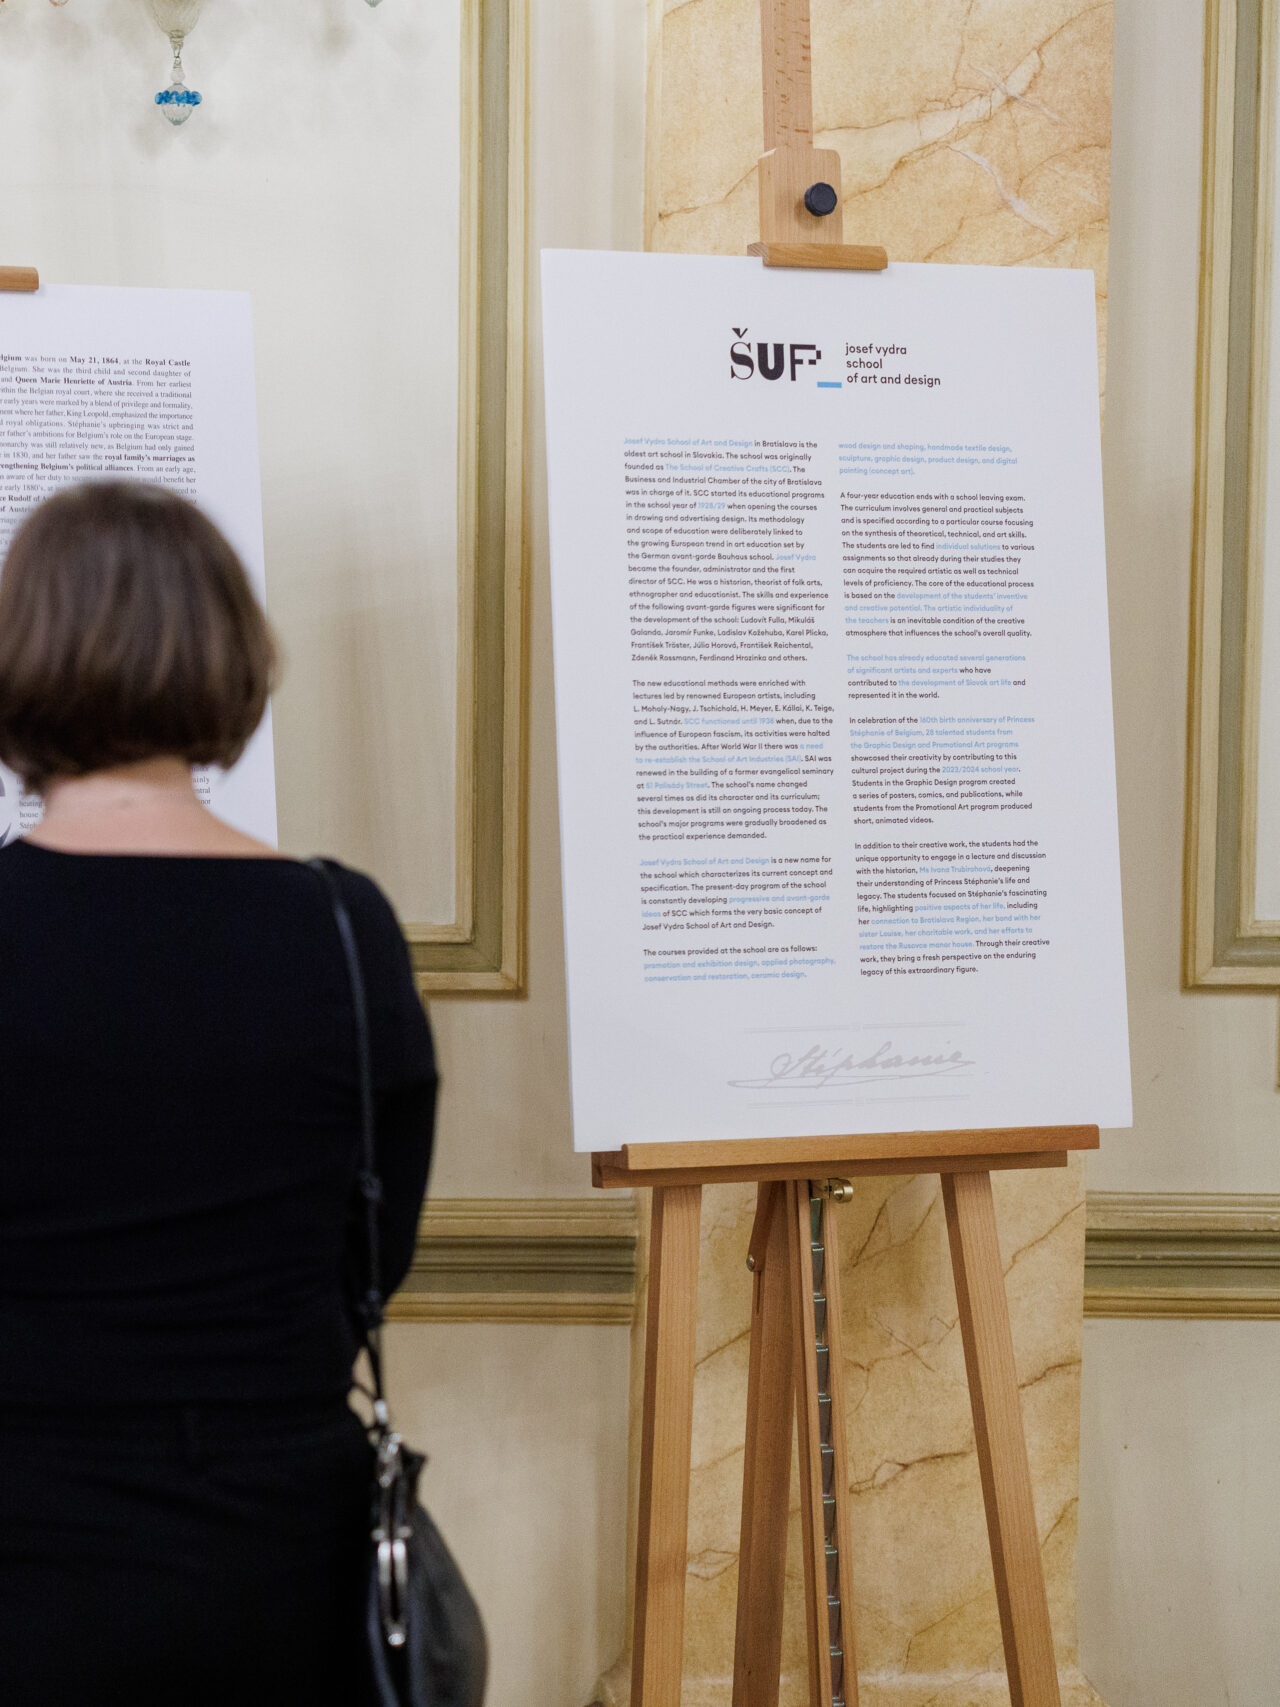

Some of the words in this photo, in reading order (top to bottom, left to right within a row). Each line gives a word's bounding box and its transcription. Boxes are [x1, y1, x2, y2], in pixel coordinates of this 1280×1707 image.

[845, 342, 873, 356] josef
[875, 344, 907, 357] vydra
[69, 355, 85, 364] May
[88, 356, 99, 364] 21,
[144, 358, 166, 366] Royal
[167, 359, 190, 367] Castle
[846, 357, 883, 369] school
[14, 376, 37, 384] Queen
[39, 376, 60, 384] Marie
[63, 377, 95, 385] Henriette
[97, 377, 105, 385] of
[846, 372, 860, 384] of
[861, 374, 878, 384] art
[880, 373, 901, 385] and
[904, 374, 941, 388] design
[753, 439, 761, 447] in
[761, 440, 798, 448] Bratislava
[798, 440, 805, 448] is
[659, 450, 683, 458] school
[684, 450, 691, 458] in
[692, 451, 724, 459] Slovakia.
[725, 451, 738, 459] The
[739, 452, 763, 460] school
[778, 453, 811, 461] originally
[76, 464, 103, 474] political
[624, 475, 656, 483] Business
[671, 476, 706, 484] Industrial
[707, 476, 740, 484] Chamber
[750, 477, 762, 485] the
[763, 478, 777, 486] city
[777, 477, 786, 485] of
[786, 478, 822, 486] Bratislava
[7, 494, 31, 502] Rudolf
[33, 494, 40, 502] of
[955, 493, 978, 501] school
[978, 494, 1004, 502] leaving
[1006, 629, 1032, 637] quality.
[851, 779, 883, 787] Students
[904, 778, 933, 786] Graphic
[933, 778, 957, 786] Design
[642, 922, 663, 931] Josef
[662, 922, 685, 930] Vydra
[685, 921, 710, 929] School
[710, 921, 719, 929] of
[747, 920, 774, 928] Design.
[642, 948, 657, 956] The
[686, 947, 719, 955] provided
[742, 946, 767, 954] school
[789, 944, 818, 952] follows:
[859, 969, 884, 977] legacy
[884, 967, 893, 975] of
[892, 967, 907, 975] this
[907, 966, 955, 974] extraordinary
[955, 965, 978, 974] figure.
